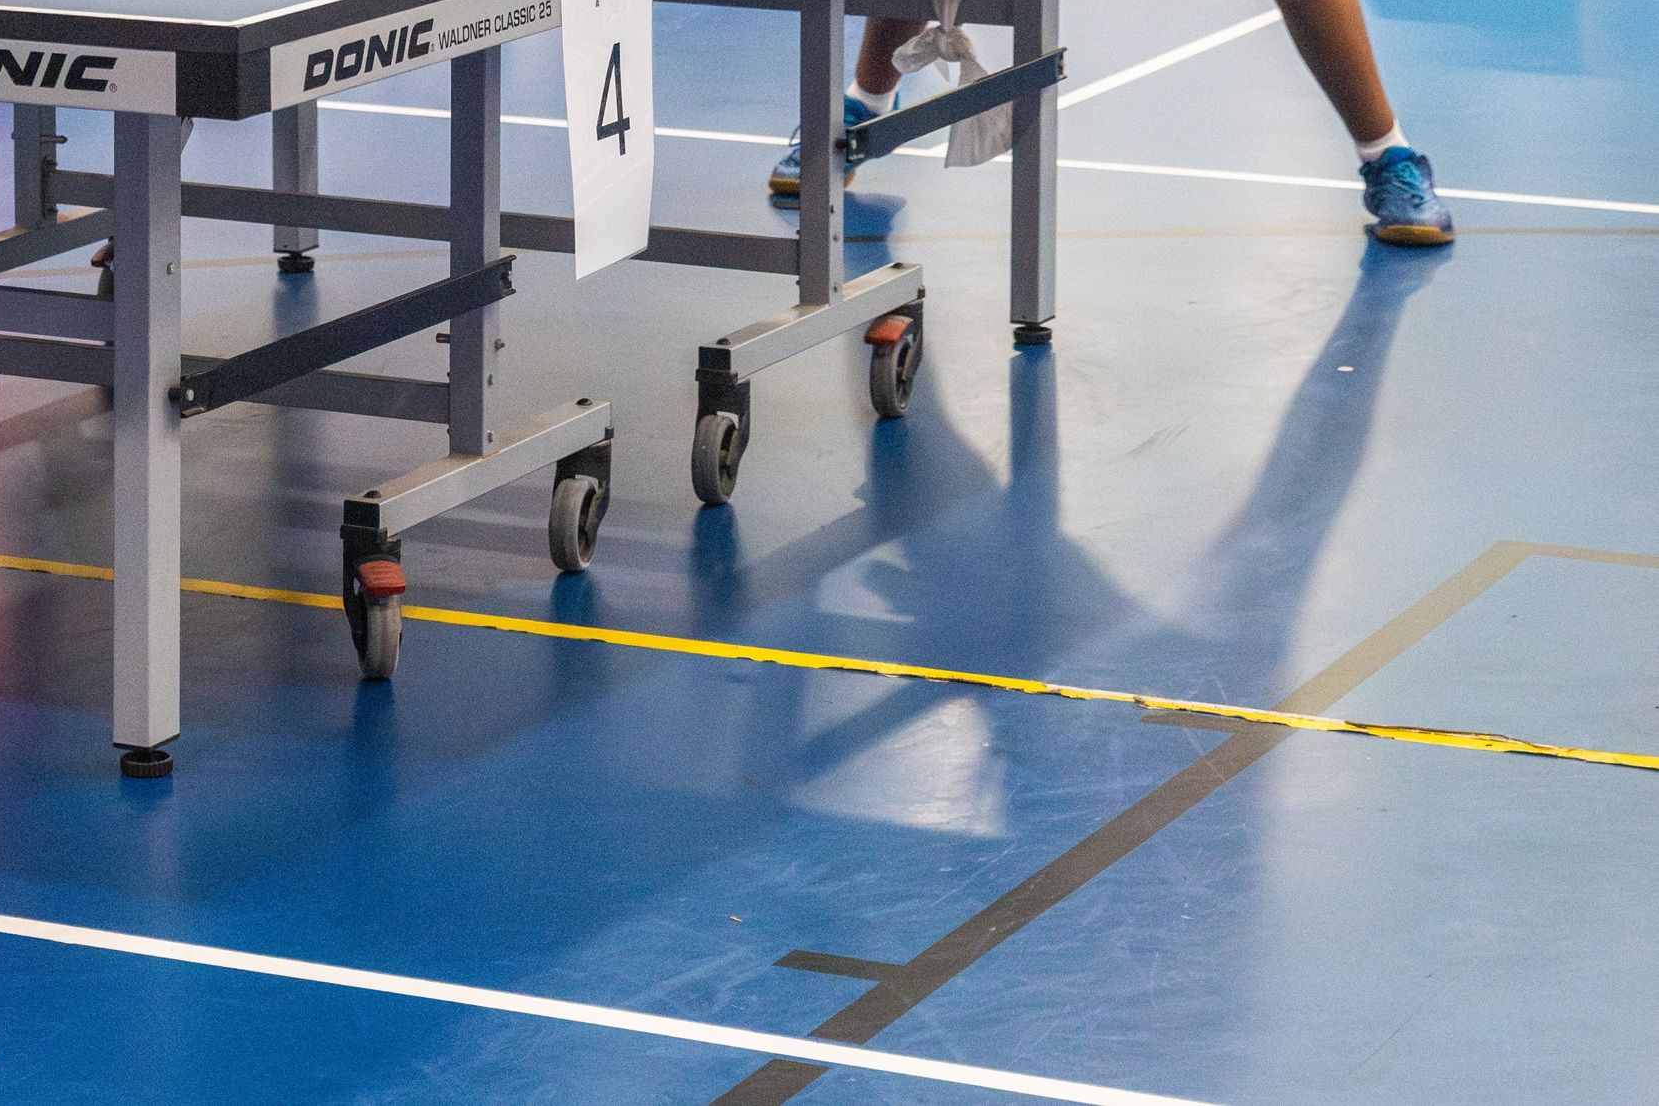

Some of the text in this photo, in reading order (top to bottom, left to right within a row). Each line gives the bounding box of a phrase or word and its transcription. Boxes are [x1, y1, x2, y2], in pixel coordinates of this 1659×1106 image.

[303, 0, 552, 92] DONIC WALDNER CLASSIC 25
[596, 41, 631, 156] 4
